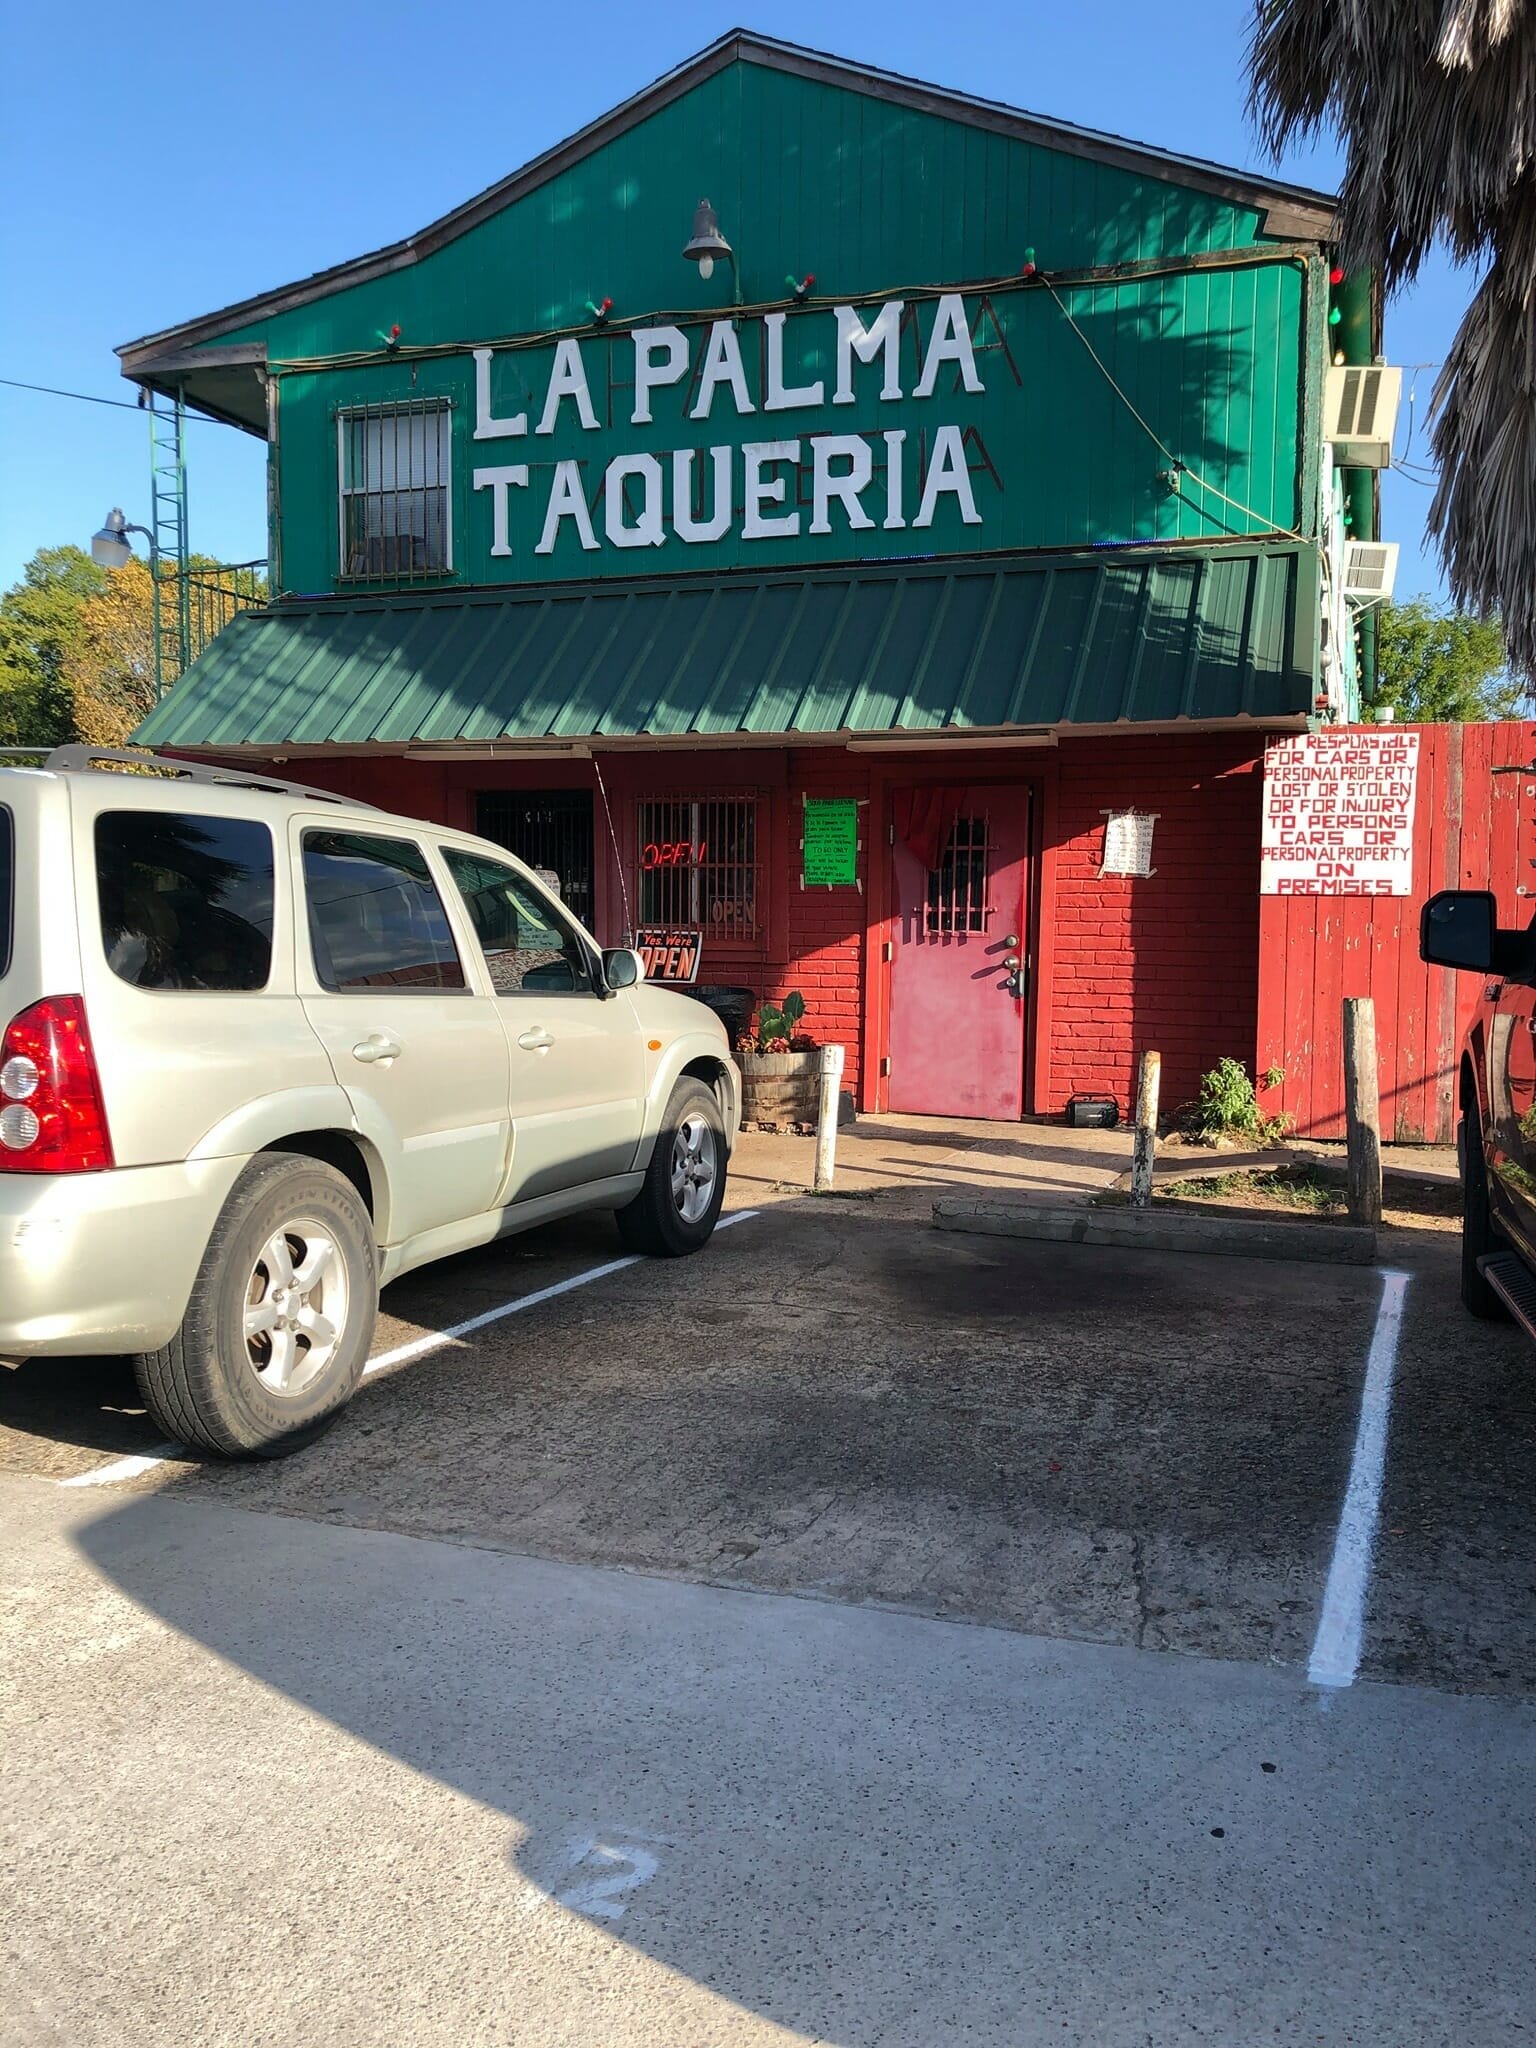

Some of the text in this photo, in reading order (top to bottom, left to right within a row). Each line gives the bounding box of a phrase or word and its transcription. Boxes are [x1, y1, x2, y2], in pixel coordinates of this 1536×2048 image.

[472, 293, 986, 440] LA PALMA
[472, 425, 983, 556] TAQUERIA
[1265, 750, 1407, 765] FOR CARS OR
[1263, 766, 1415, 781] PERSONAL PROPERTY
[1271, 782, 1411, 797] LOST OR STOLEN
[1270, 798, 1409, 813] OR FOR INJURY
[1268, 815, 1407, 828] TO PERSONS
[1280, 831, 1396, 845] CARS OR
[642, 842, 706, 869] OPEN
[1261, 847, 1410, 861] PERSONAL PROPERTY
[1316, 863, 1354, 877] ON
[1278, 879, 1392, 895] PREMISES
[712, 900, 753, 922] OPEN
[638, 947, 696, 979] OPEN
